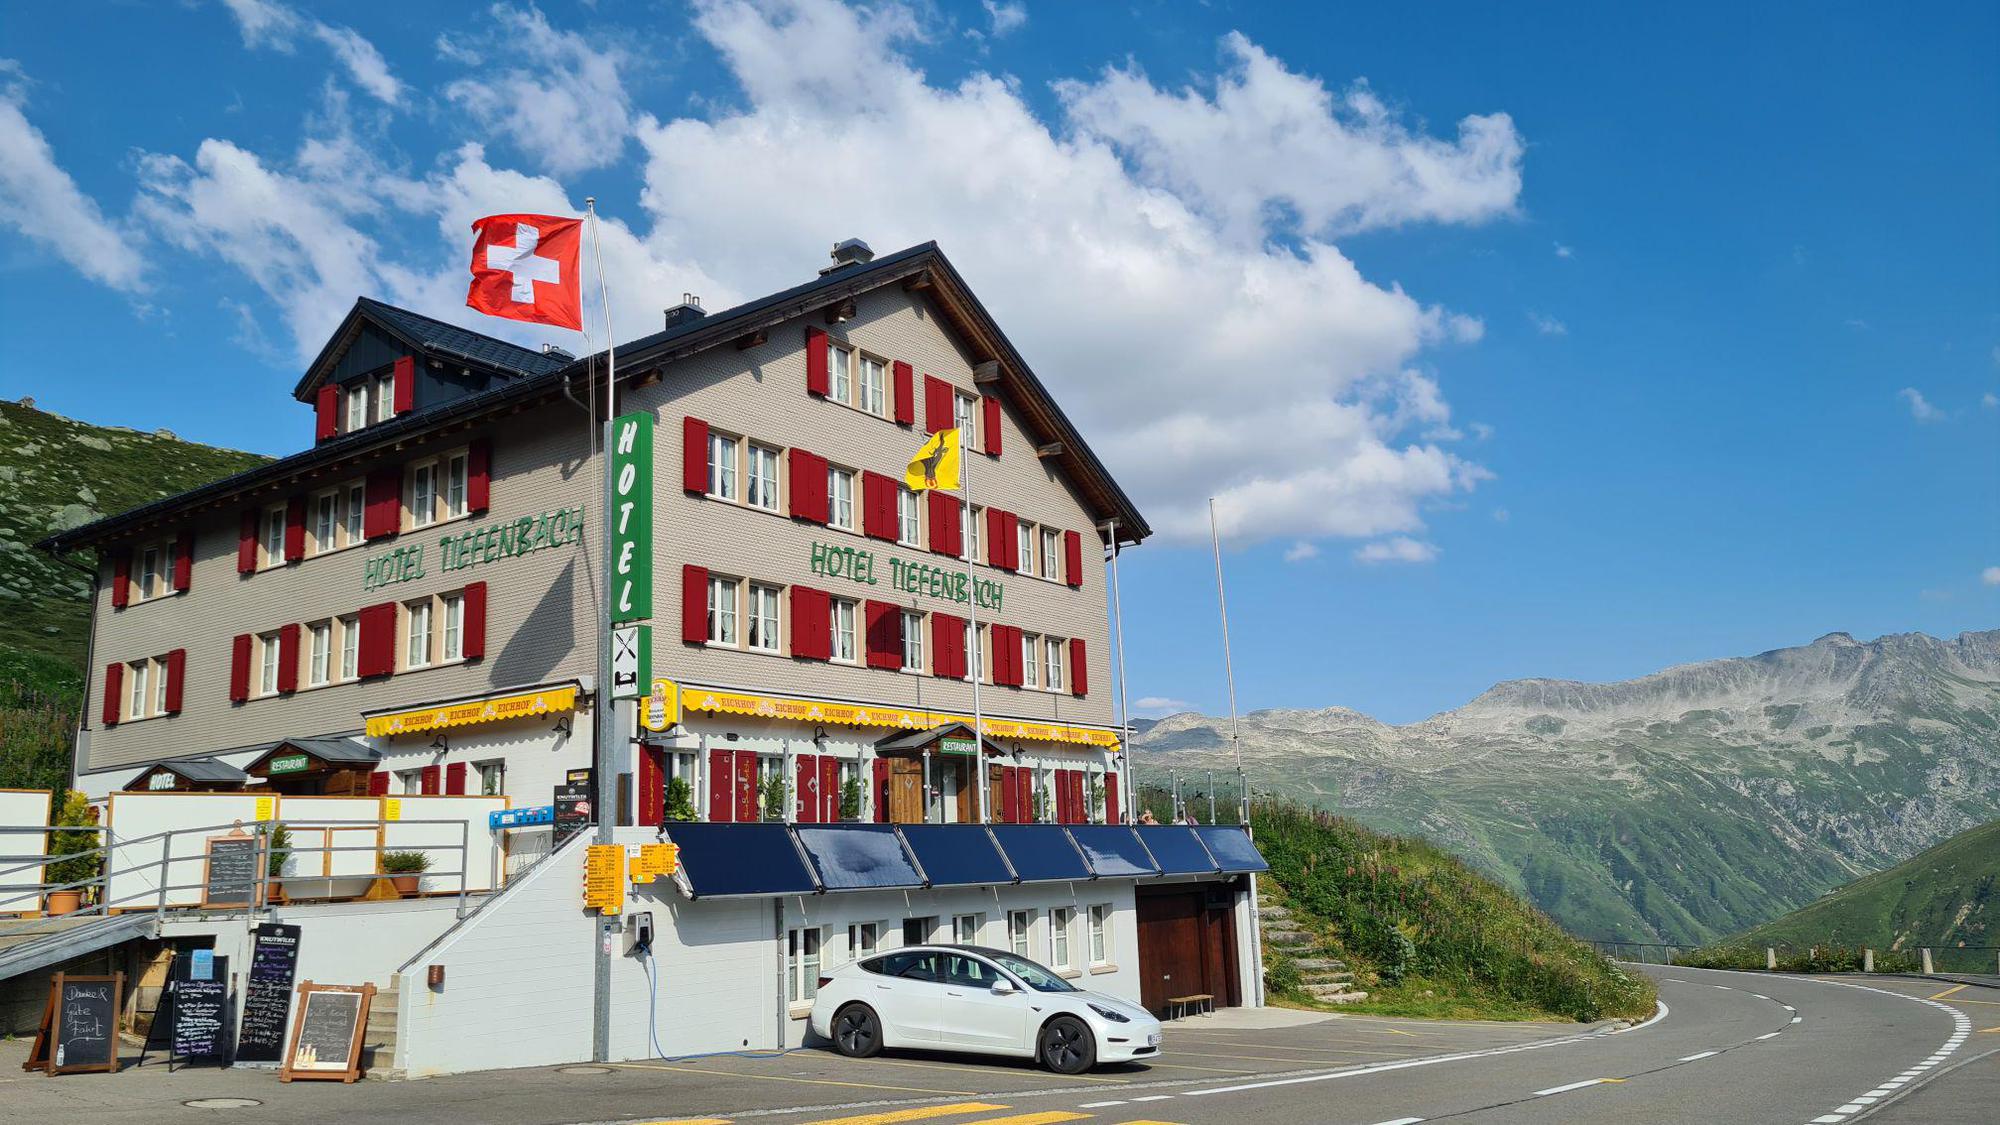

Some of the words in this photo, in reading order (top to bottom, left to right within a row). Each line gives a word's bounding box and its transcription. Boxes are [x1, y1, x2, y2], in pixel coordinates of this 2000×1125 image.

[617, 421, 638, 613] HOTEL
[364, 544, 425, 592] HOTEL
[440, 503, 585, 573] TIEFENBACH
[811, 541, 877, 585] HOTEL
[889, 557, 1003, 613] TIEFENBACH
[404, 714, 433, 727] EICHHOF
[450, 707, 480, 720] EICHHOF
[497, 700, 530, 713] EICHHOF
[721, 697, 756, 709] EICHHOF
[775, 703, 807, 715] EICHHOF
[824, 708, 854, 719] EICHHOF
[943, 741, 977, 752] RESTAURANT
[271, 756, 307, 772] RESTAURANT
[150, 773, 175, 790] HOTEL
[66, 985, 98, 1001] Danke
[65, 1003, 91, 1022] Gute
[66, 1018, 103, 1036] Fahrt
